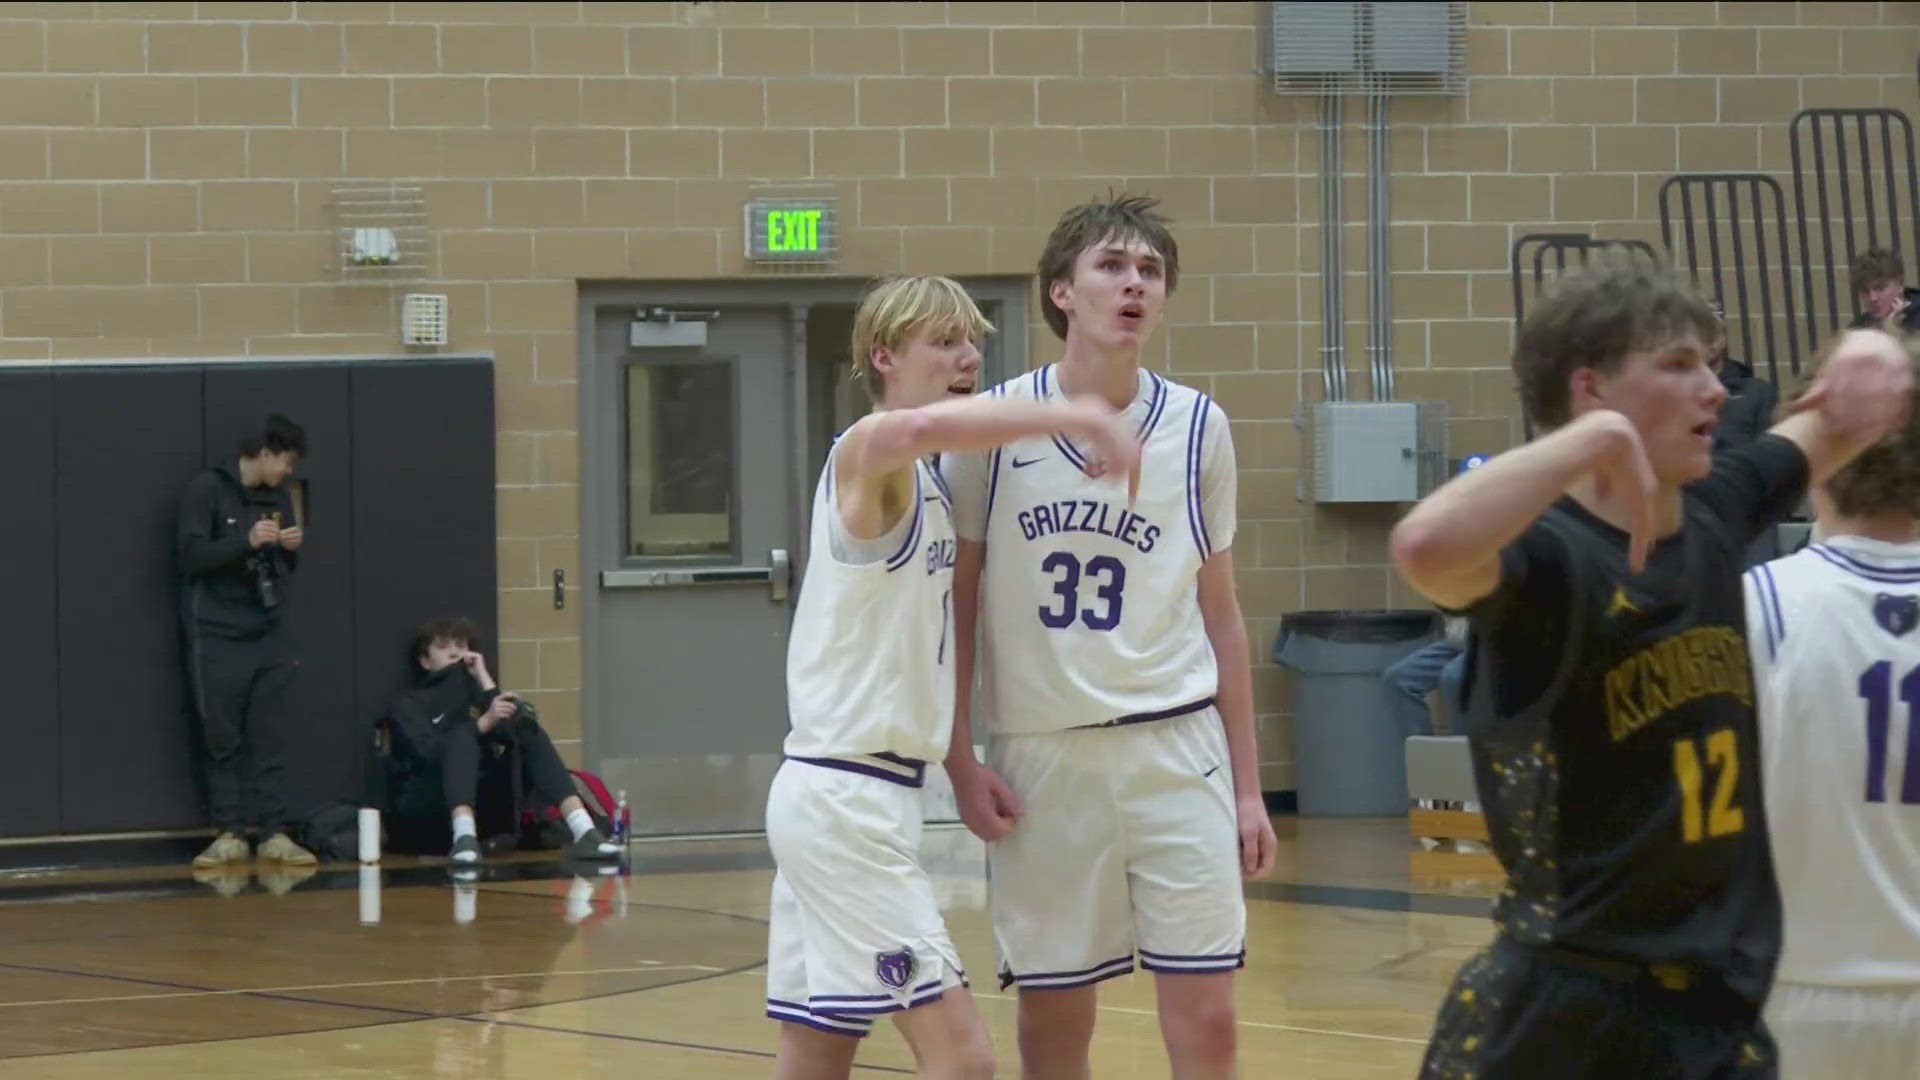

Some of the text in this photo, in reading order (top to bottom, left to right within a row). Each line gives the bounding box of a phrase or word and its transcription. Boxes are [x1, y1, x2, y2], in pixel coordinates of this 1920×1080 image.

[767, 210, 821, 252] EXIT
[1018, 500, 1161, 554] GRIZZLIES
[1038, 551, 1126, 632] 33
[1674, 728, 1745, 844] 12
